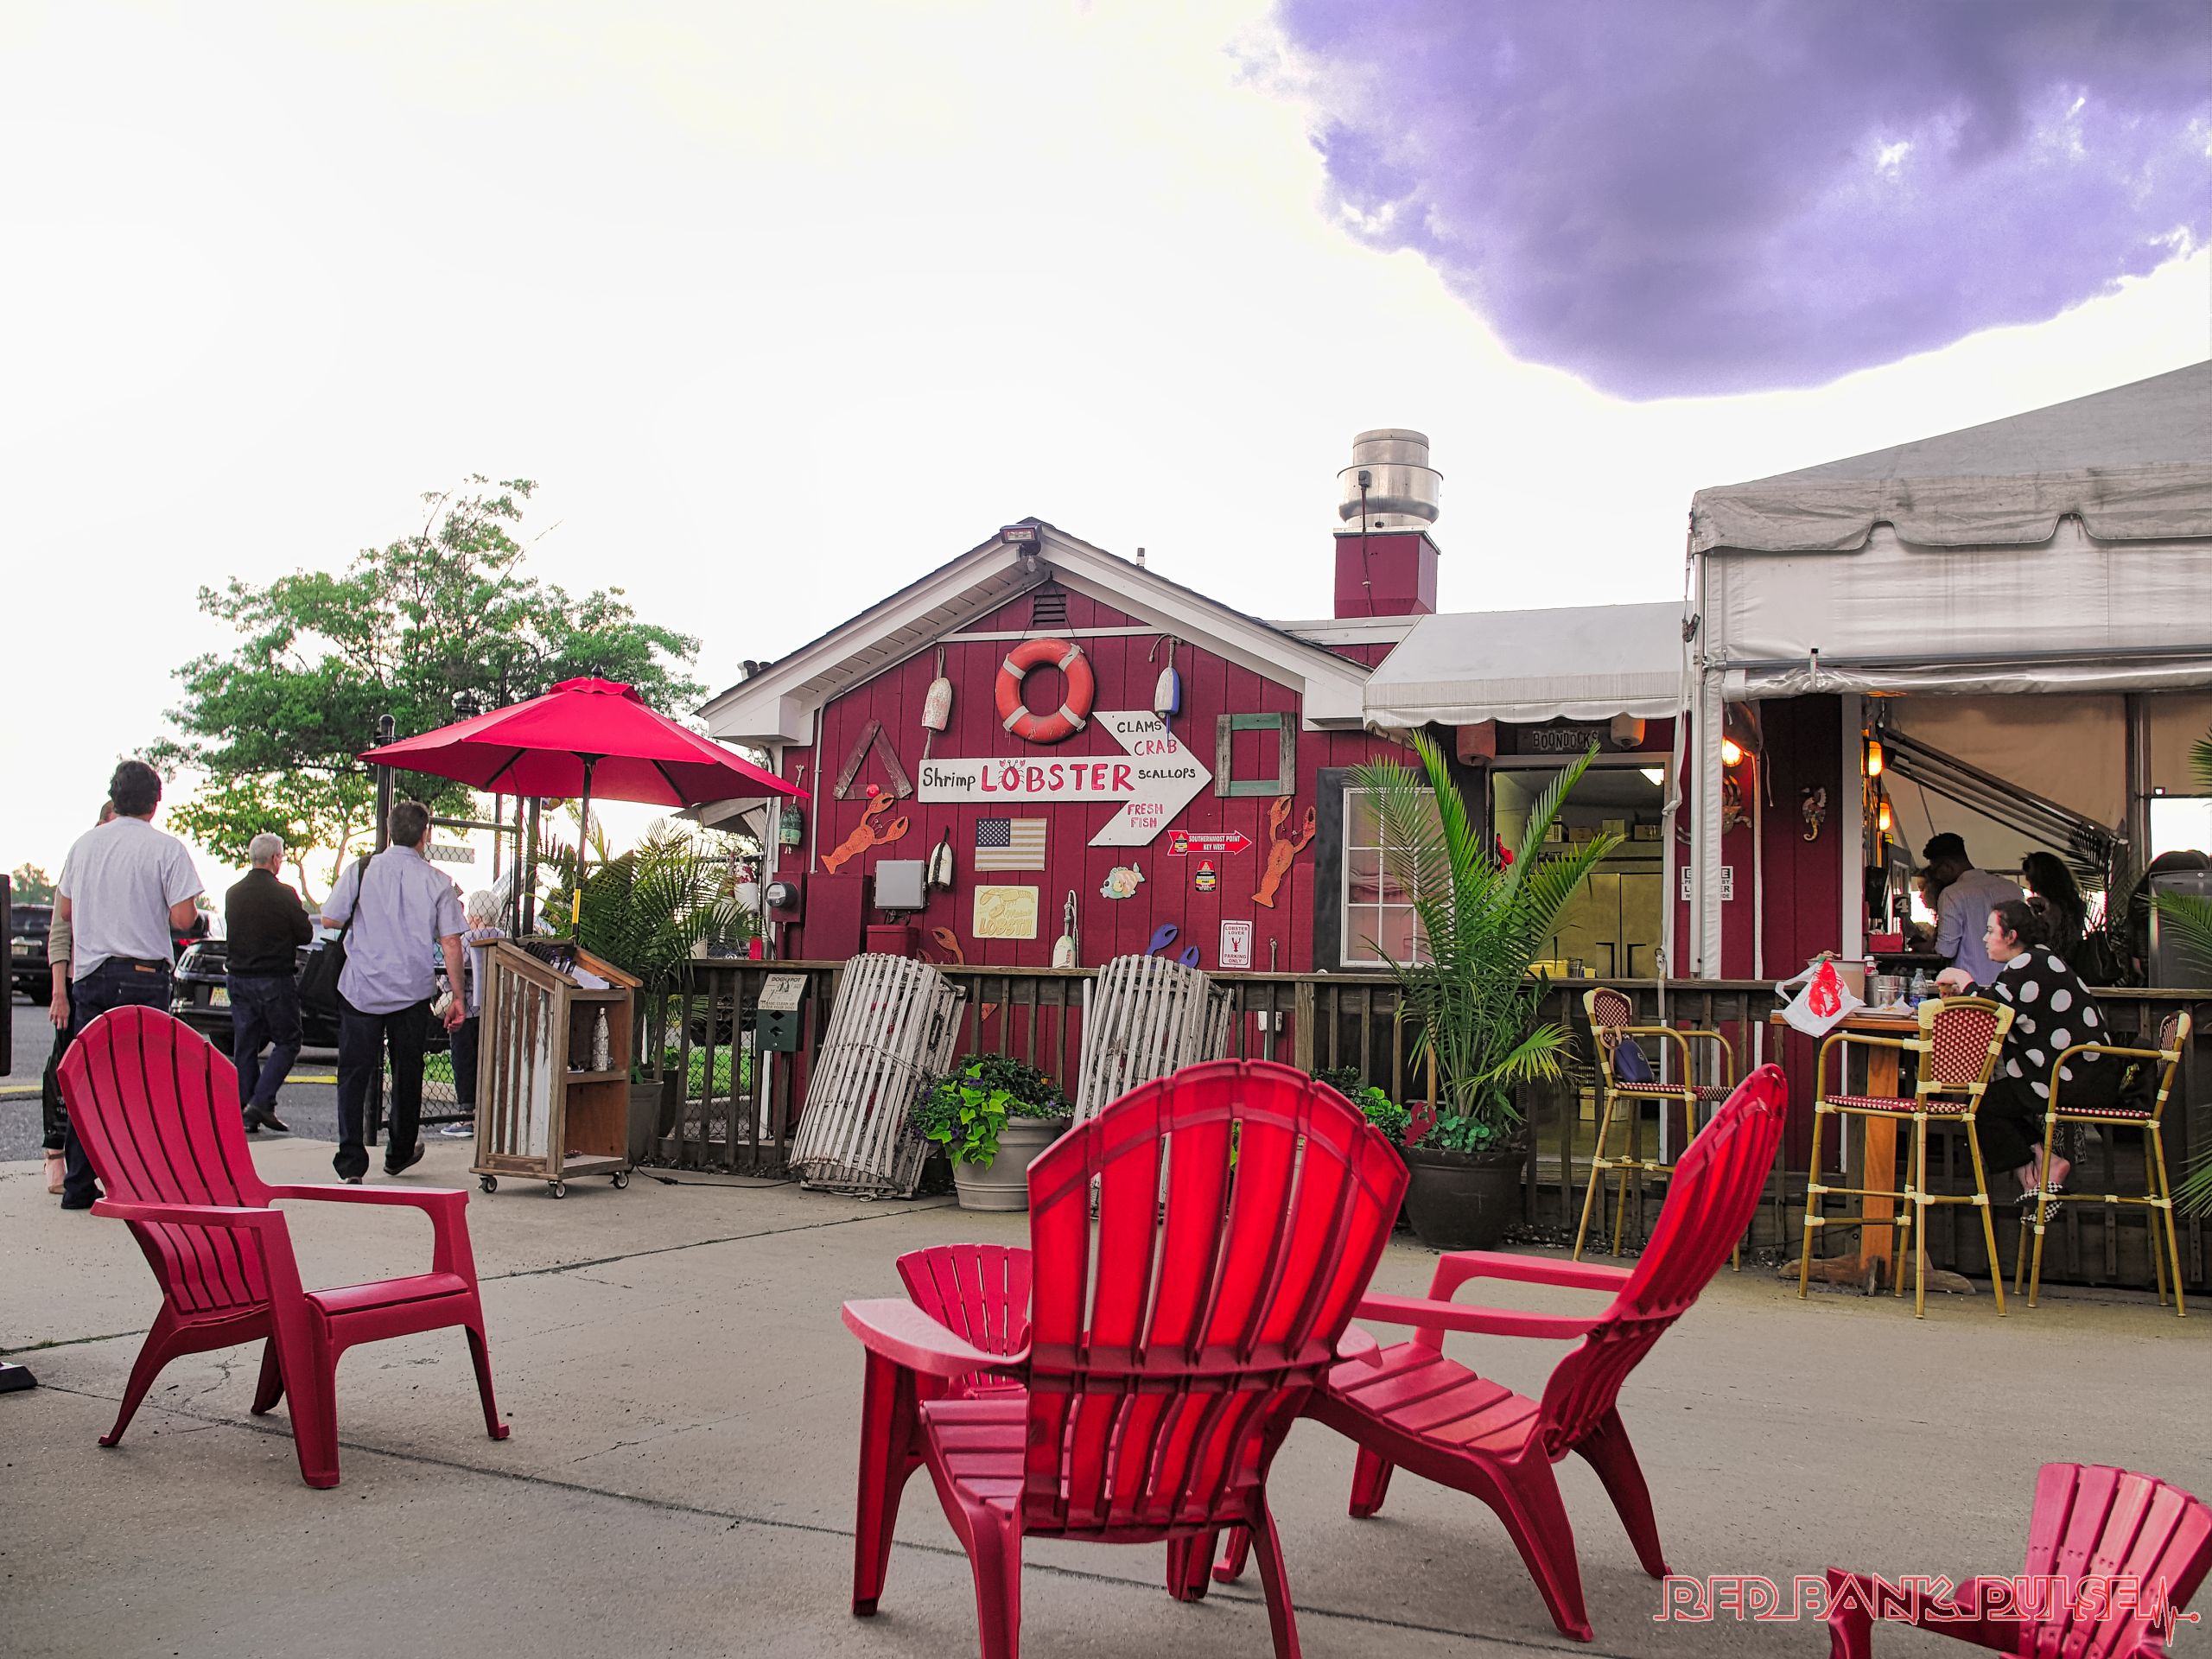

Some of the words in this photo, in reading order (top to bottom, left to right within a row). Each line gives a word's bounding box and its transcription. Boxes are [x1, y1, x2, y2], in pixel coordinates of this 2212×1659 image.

[1116, 720, 1163, 734] CLAMS
[1533, 730, 1599, 749] BOONDOCKS
[1134, 739, 1178, 757] CRAB
[922, 767, 976, 791] Shrimp
[981, 763, 1135, 792] LOBSTER
[1138, 767, 1197, 779] SCALLOPS
[1127, 803, 1164, 816] FRESH
[1130, 817, 1158, 829] FISH
[1895, 898, 1909, 913] 4
